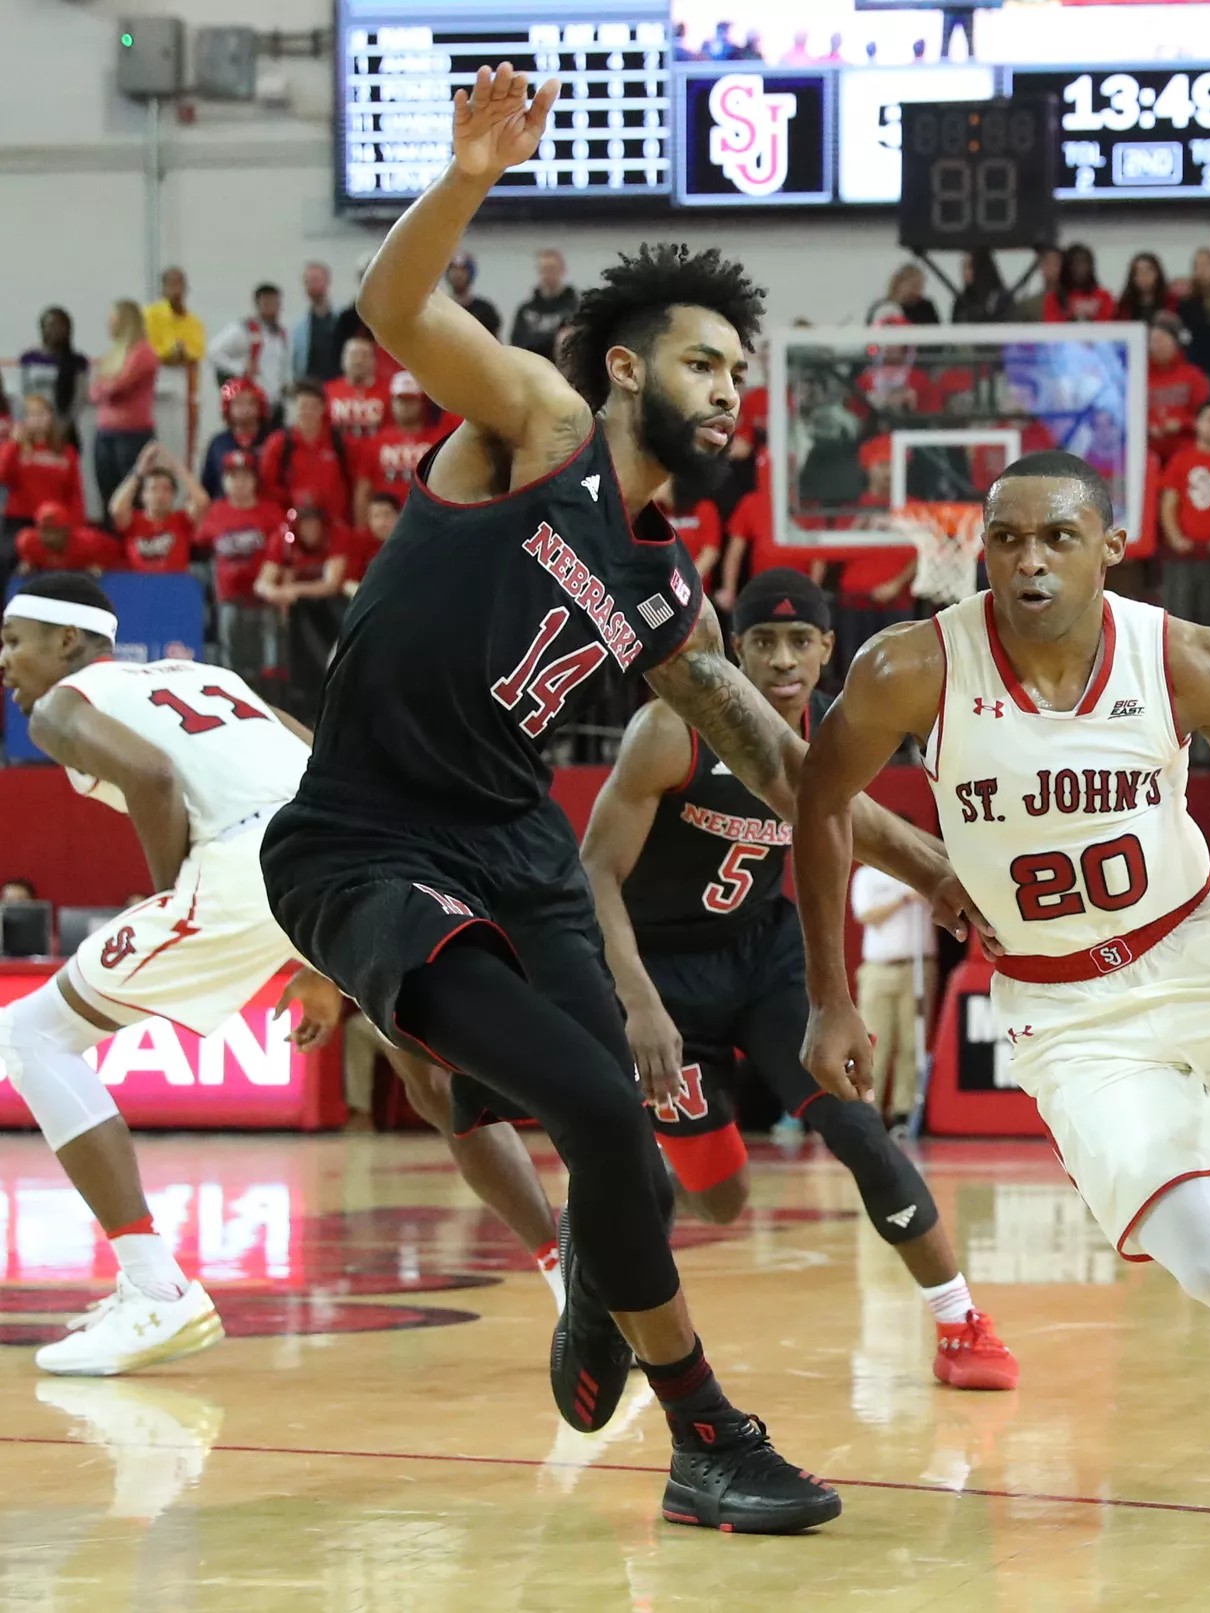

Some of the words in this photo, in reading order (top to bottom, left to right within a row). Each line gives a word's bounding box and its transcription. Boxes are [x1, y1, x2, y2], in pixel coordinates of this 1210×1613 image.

[522, 521, 643, 673] NEBRASKA
[490, 606, 608, 739] 14
[148, 684, 273, 735] 11
[1110, 706, 1145, 716] EAST
[1113, 699, 1138, 708] BIG
[956, 778, 1005, 823] ST.
[1022, 768, 1162, 817] JOHN'S
[680, 802, 793, 845] NEBRAS
[702, 842, 770, 914] 5
[1010, 833, 1148, 921] 20
